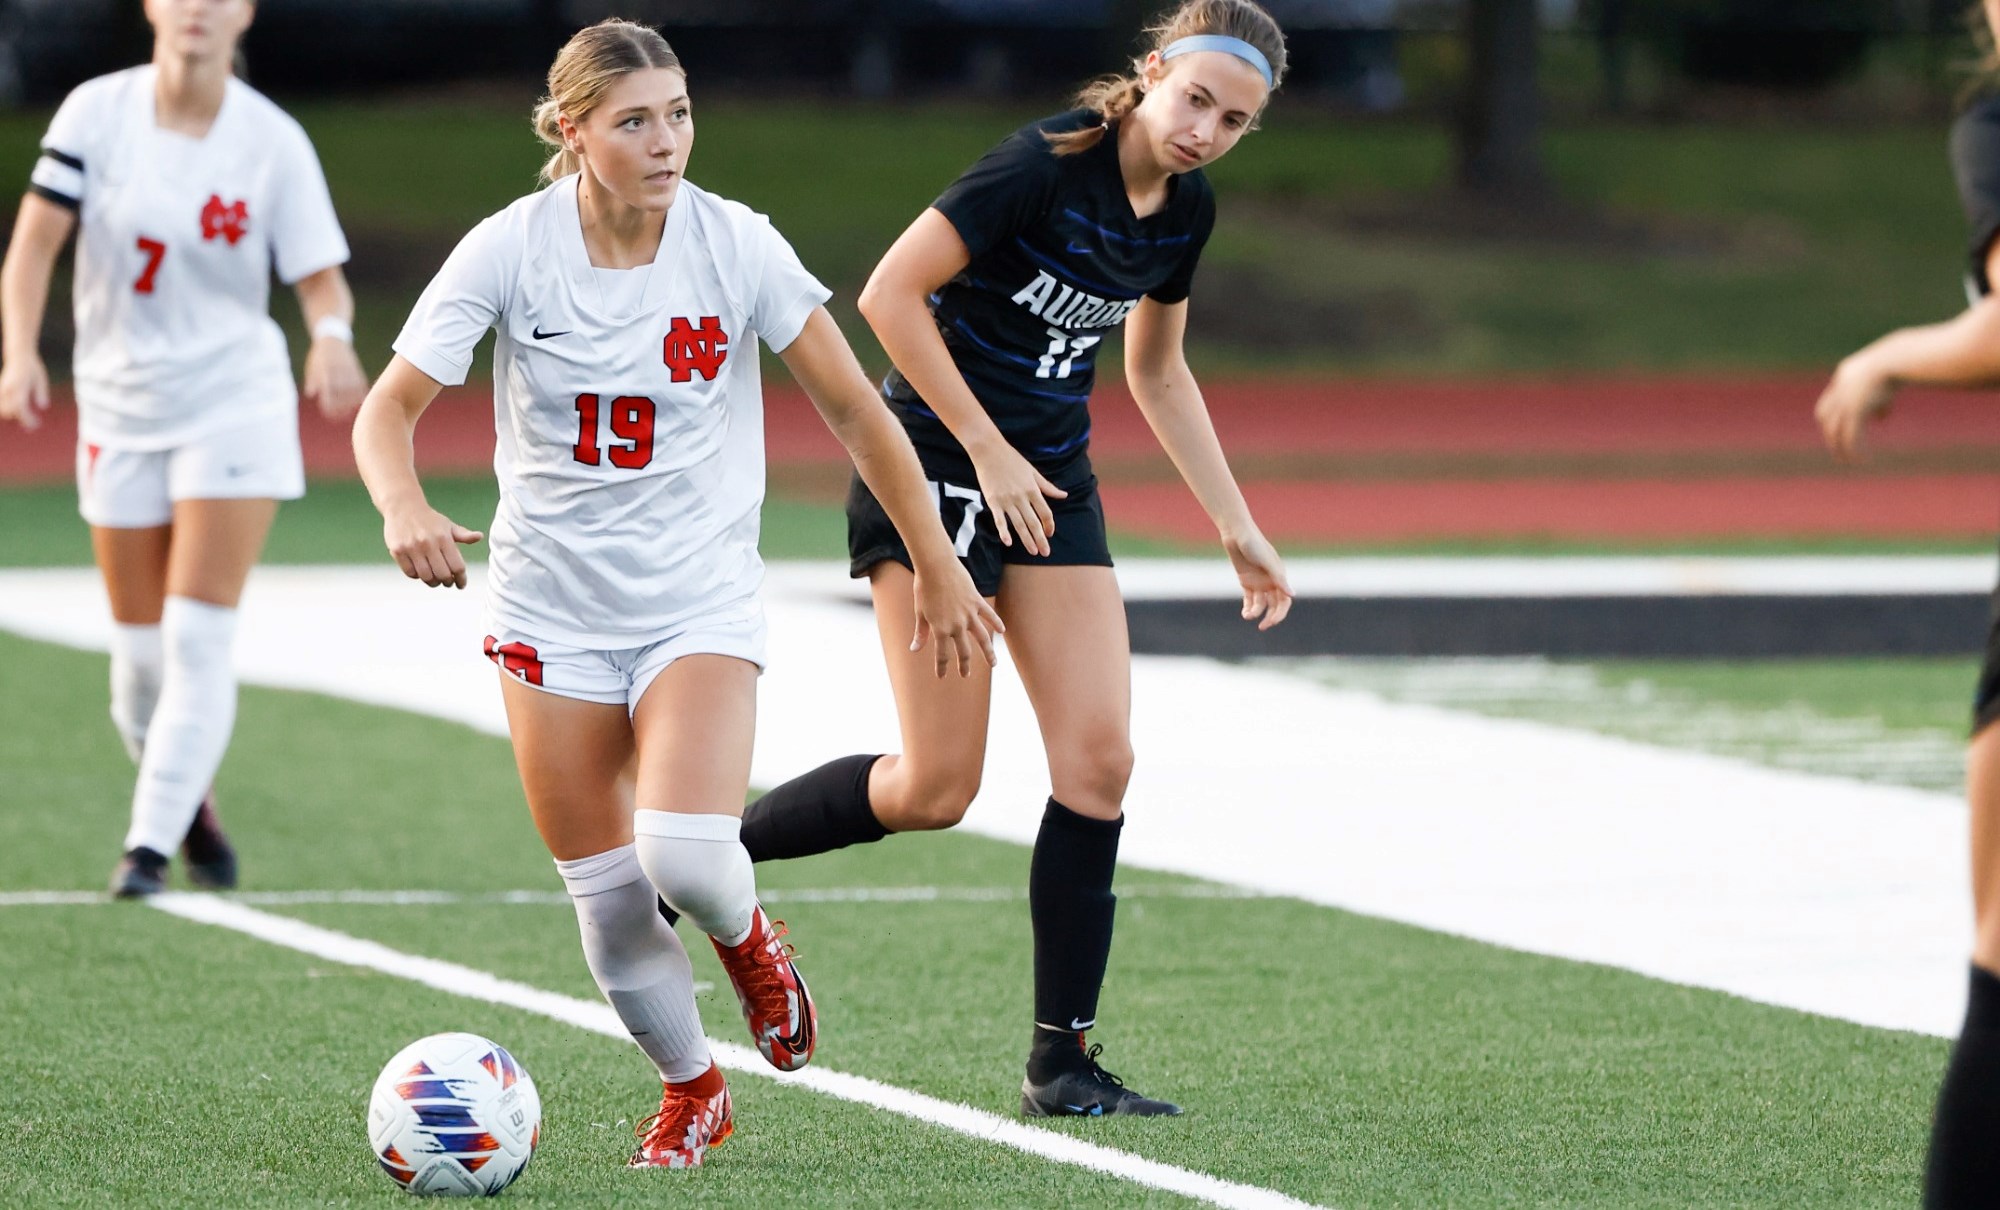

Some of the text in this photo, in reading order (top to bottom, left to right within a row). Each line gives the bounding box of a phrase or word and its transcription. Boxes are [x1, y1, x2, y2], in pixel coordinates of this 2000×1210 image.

[135, 236, 165, 294] 7
[1011, 269, 1138, 329] AUROR
[573, 393, 656, 470] 19
